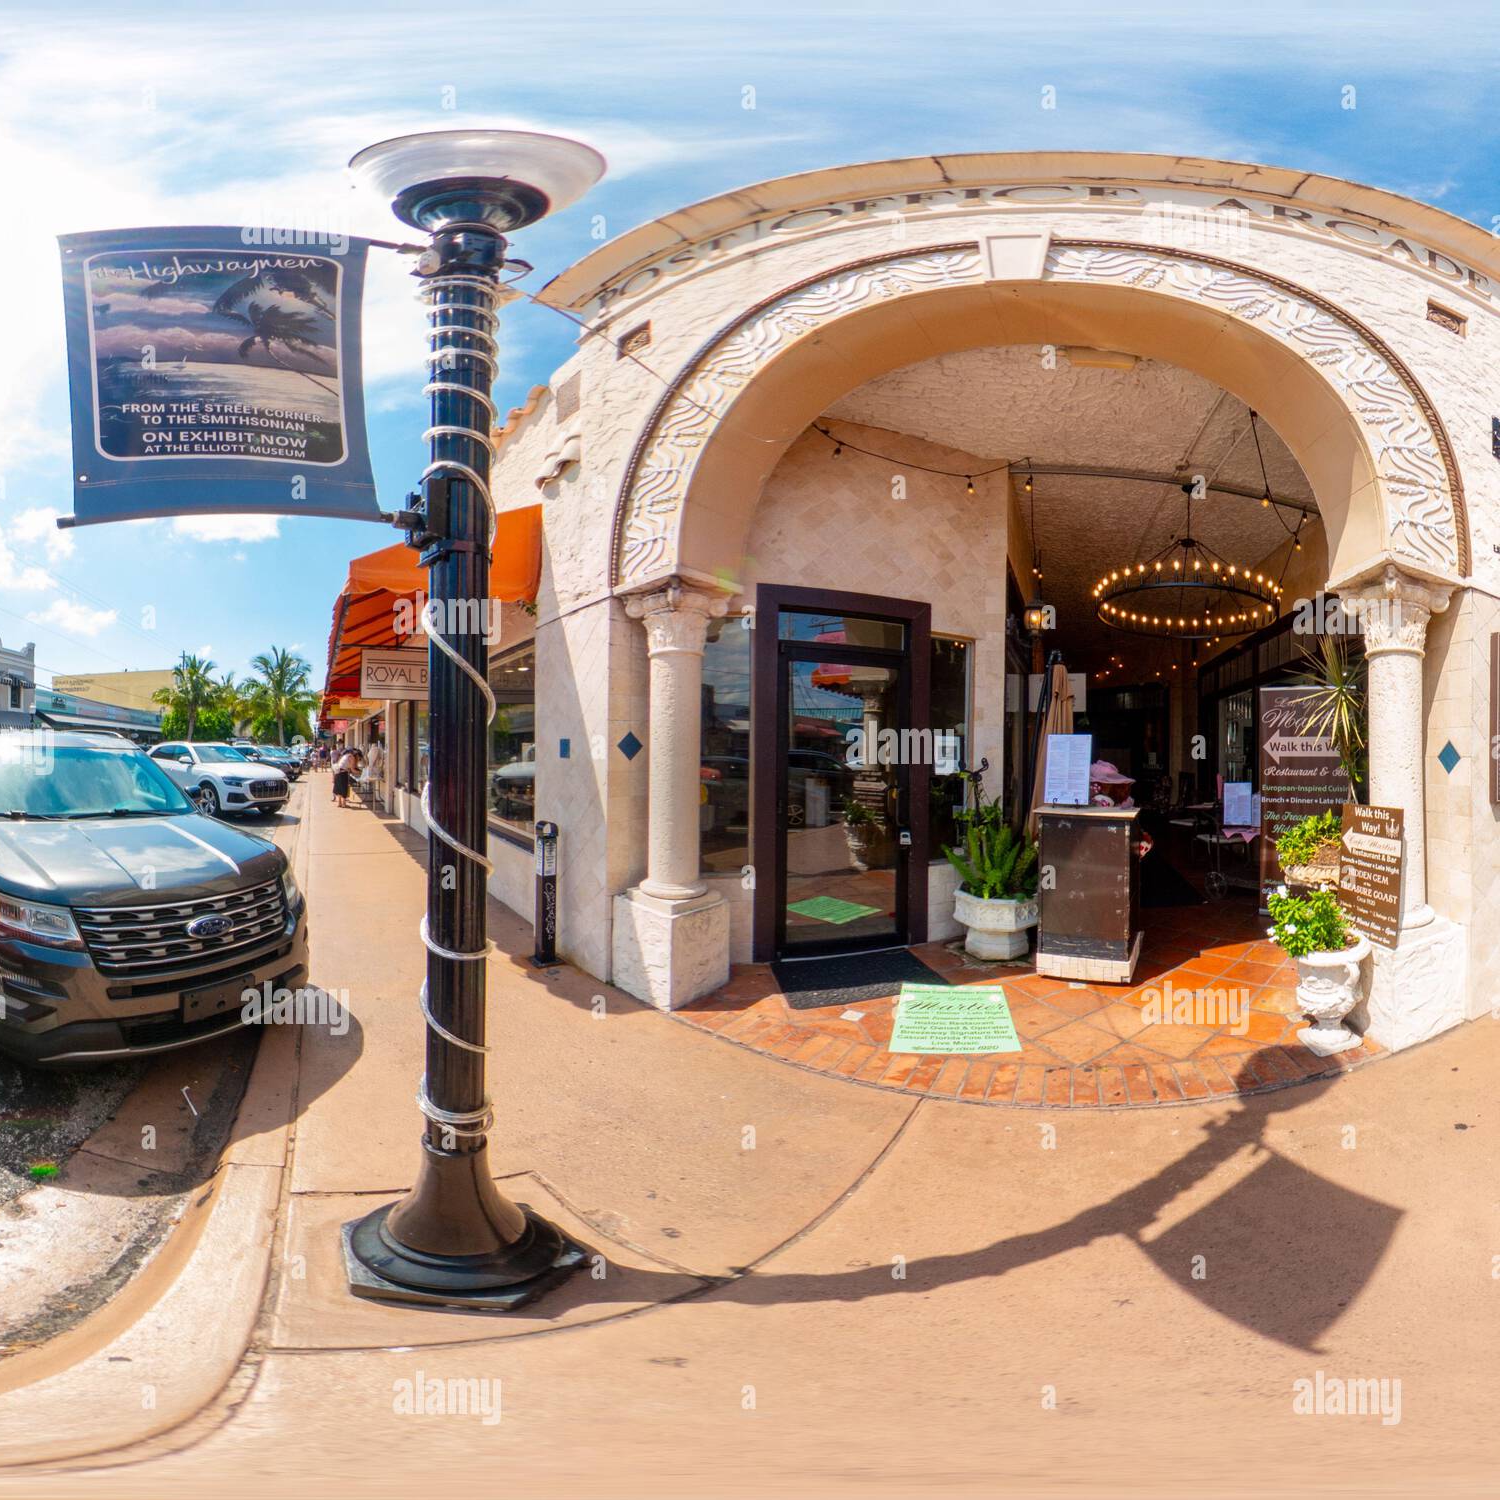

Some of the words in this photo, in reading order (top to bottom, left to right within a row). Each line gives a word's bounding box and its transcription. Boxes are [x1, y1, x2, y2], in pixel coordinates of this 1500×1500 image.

[597, 232, 738, 318] POST
[770, 185, 1143, 235] OFFICE
[1210, 197, 1492, 299] ARCADE
[129, 255, 323, 284] Highwaymen
[122, 404, 165, 414] FROM
[170, 403, 200, 413] THE
[205, 404, 260, 415] STREET
[264, 408, 323, 424] CORNER
[141, 415, 162, 425] TO
[166, 415, 197, 425] THE
[202, 415, 305, 432] SMITHSONIAN
[142, 432, 173, 443] ON
[179, 432, 254, 443] EXHIBIT
[261, 435, 308, 449] NOW
[144, 446, 162, 454] AT
[165, 444, 190, 453] THE
[194, 444, 246, 454] ELLIOTT
[250, 446, 307, 459] MUSEUM
[367, 666, 416, 683] ROYAL
[1270, 742, 1298, 752] Walk
[1263, 766, 1318, 777] Restaurant
[1319, 766, 1329, 777] &
[1354, 806, 1374, 818] Walk
[1374, 809, 1390, 820] this
[1361, 821, 1381, 836] Way!
[1386, 854, 1397, 863] Bar
[1373, 890, 1398, 904] COAST
